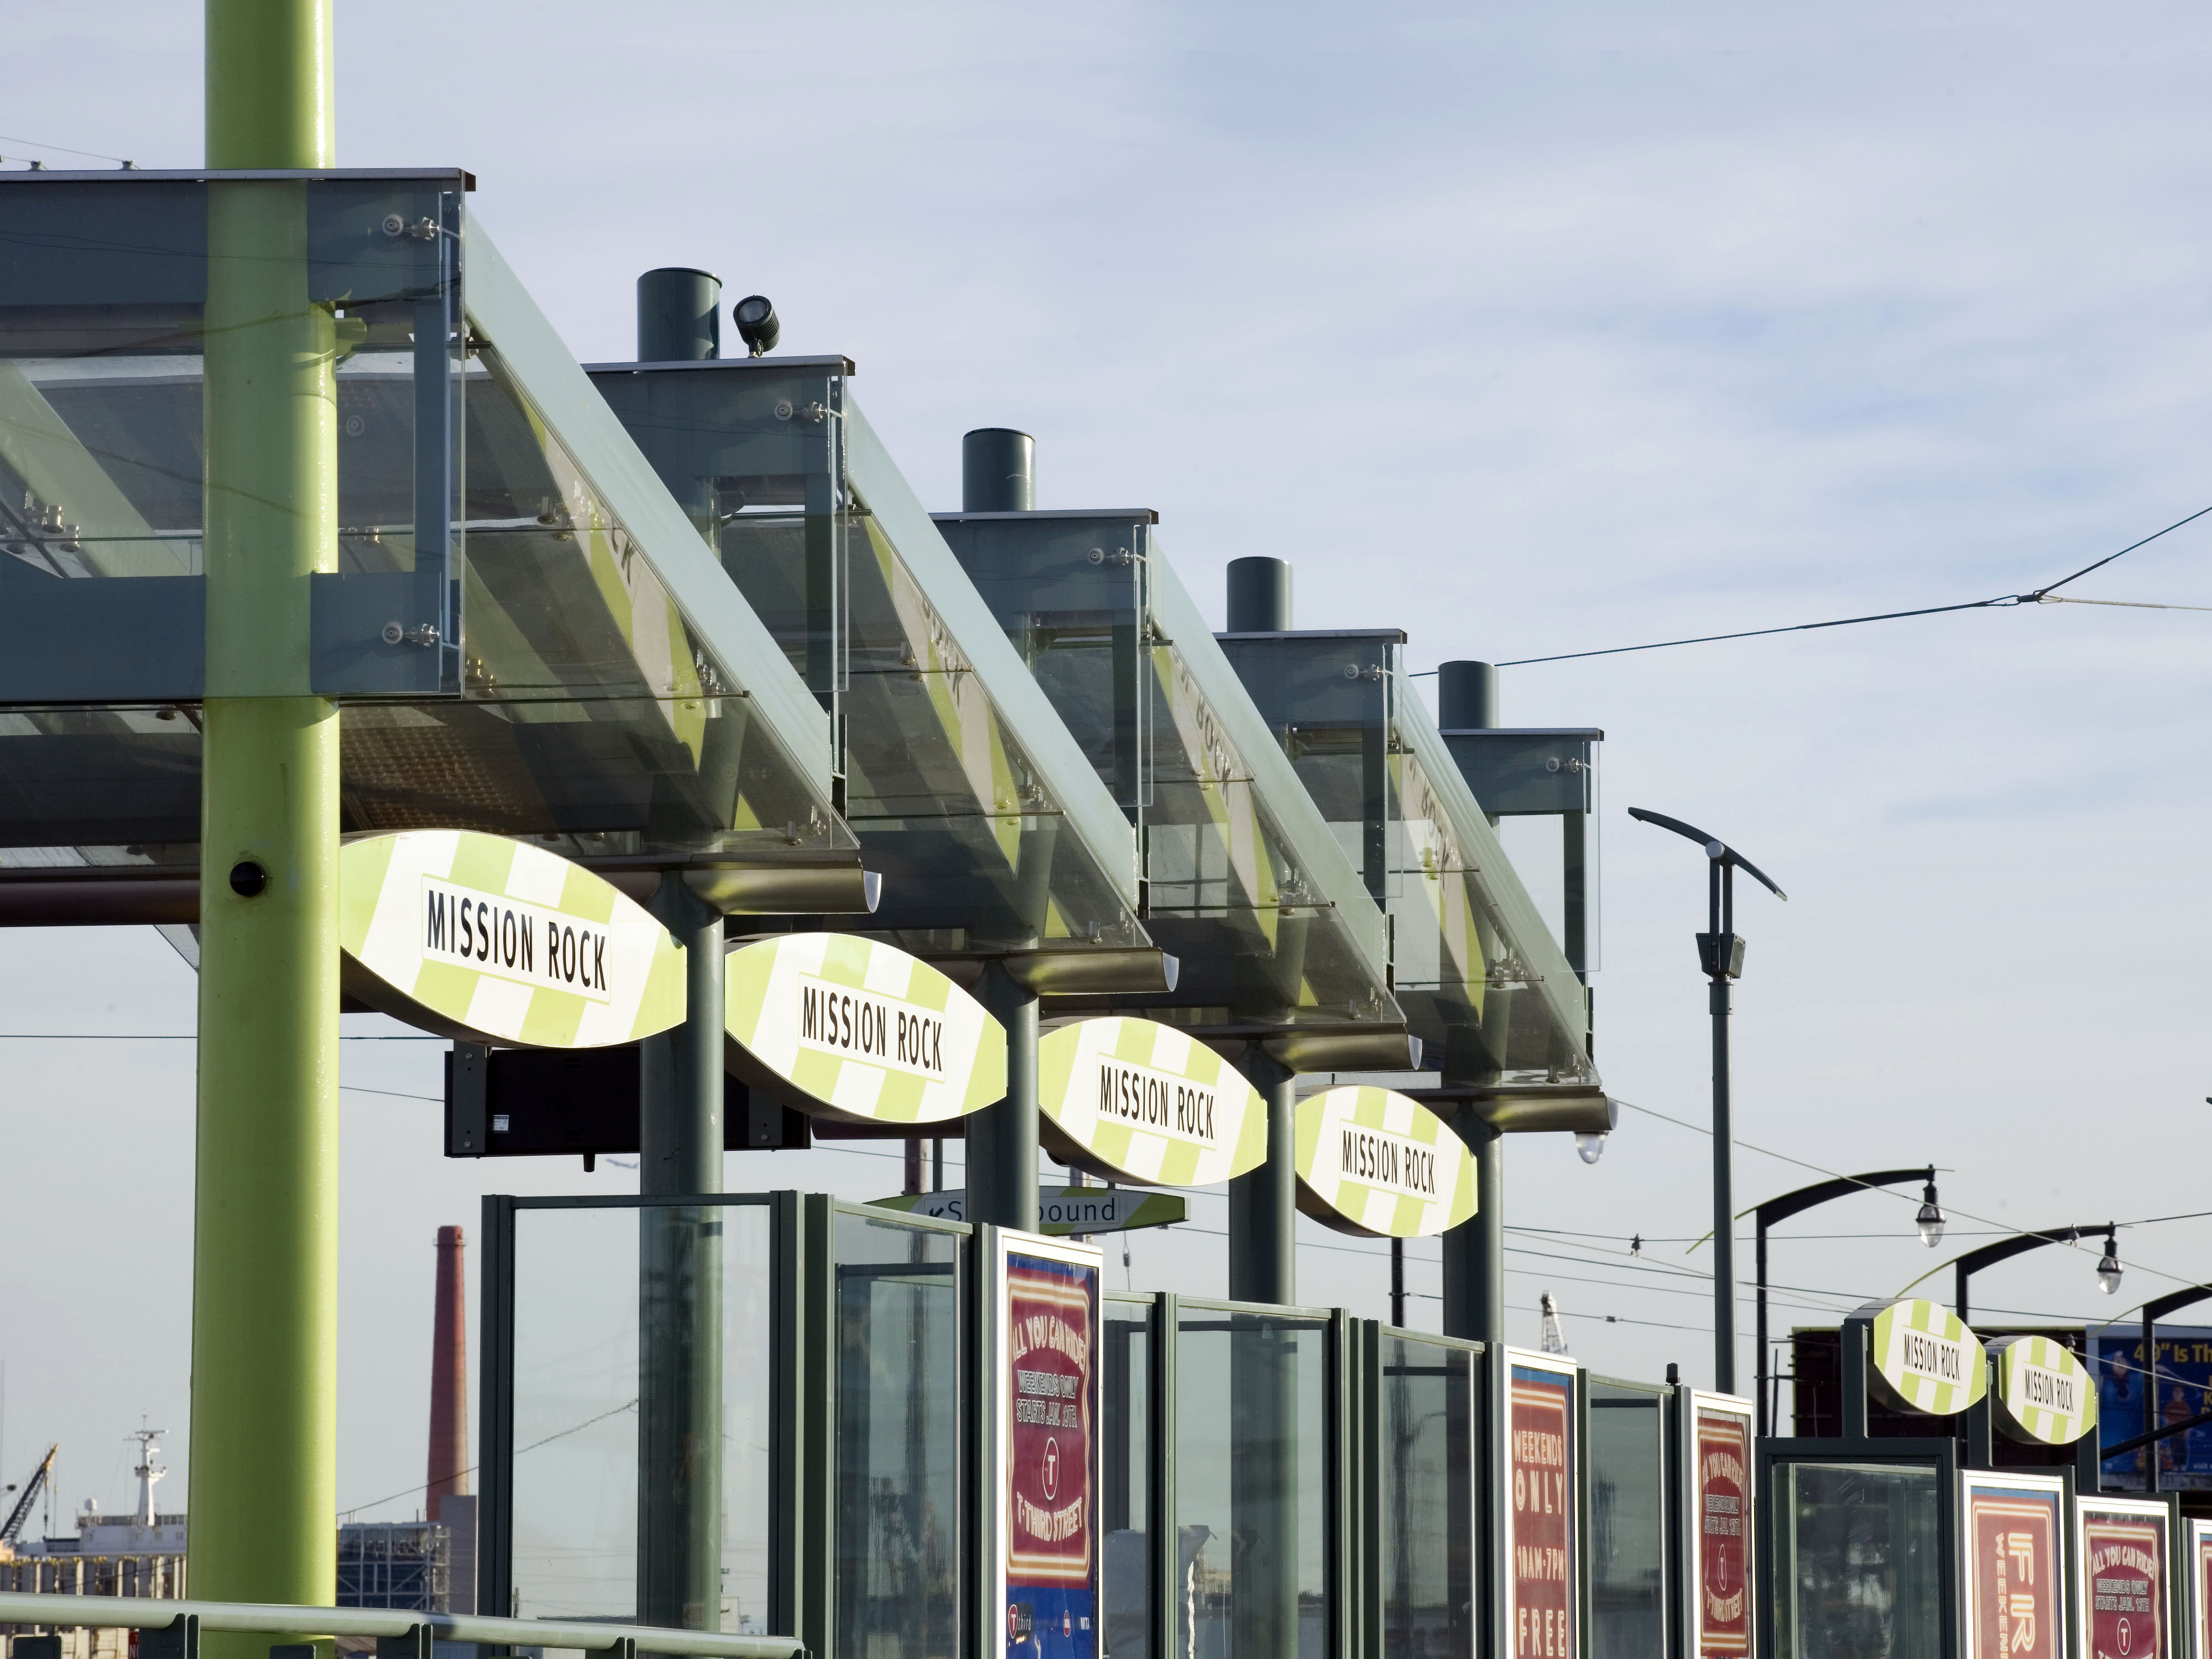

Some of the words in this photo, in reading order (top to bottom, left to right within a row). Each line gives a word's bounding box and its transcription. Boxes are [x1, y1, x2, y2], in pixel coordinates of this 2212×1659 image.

[427, 889, 533, 973] MISSION
[549, 921, 606, 992] ROCK
[802, 986, 886, 1057] MISSION
[898, 1011, 942, 1072] ROCK
[1100, 1065, 1168, 1127] MISSION
[1177, 1086, 1214, 1140] ROCK
[1342, 1130, 1397, 1185] MISSION
[1405, 1146, 1434, 1194] ROCK
[1012, 1322, 1027, 1365] ALL
[1026, 1315, 1047, 1351] YOU
[1049, 1316, 1065, 1353] CAN
[1904, 1333, 1938, 1374] MISSION
[1941, 1344, 1960, 1381] ROCK
[2173, 1344, 2189, 1363] Is
[1017, 1369, 1060, 1396] WEEKENDS
[1060, 1374, 1079, 1399] ONLY
[2025, 1369, 2054, 1405] MISSION
[2057, 1378, 2074, 1412] ROCK
[1016, 1398, 1046, 1424] STARTS
[1062, 1405, 1078, 1428] 13TH
[1514, 1430, 1562, 1467] WEEKENDS
[1709, 1452, 1721, 1479] YOU
[1515, 1468, 1563, 1515] ONLY
[1053, 1496, 1082, 1542] STREET
[2093, 1551, 2105, 1577] ALL
[2105, 1546, 2121, 1567] YOU
[2122, 1546, 2136, 1568] CAN
[2095, 1595, 2117, 1611] STARTS
[2136, 1598, 2150, 1613] 13TH
[2096, 1578, 2130, 1594] WEEKENDS
[2131, 1579, 2148, 1595] ONLY
[1018, 1613, 1031, 1631] third
[1519, 1608, 1565, 1657] FREE
